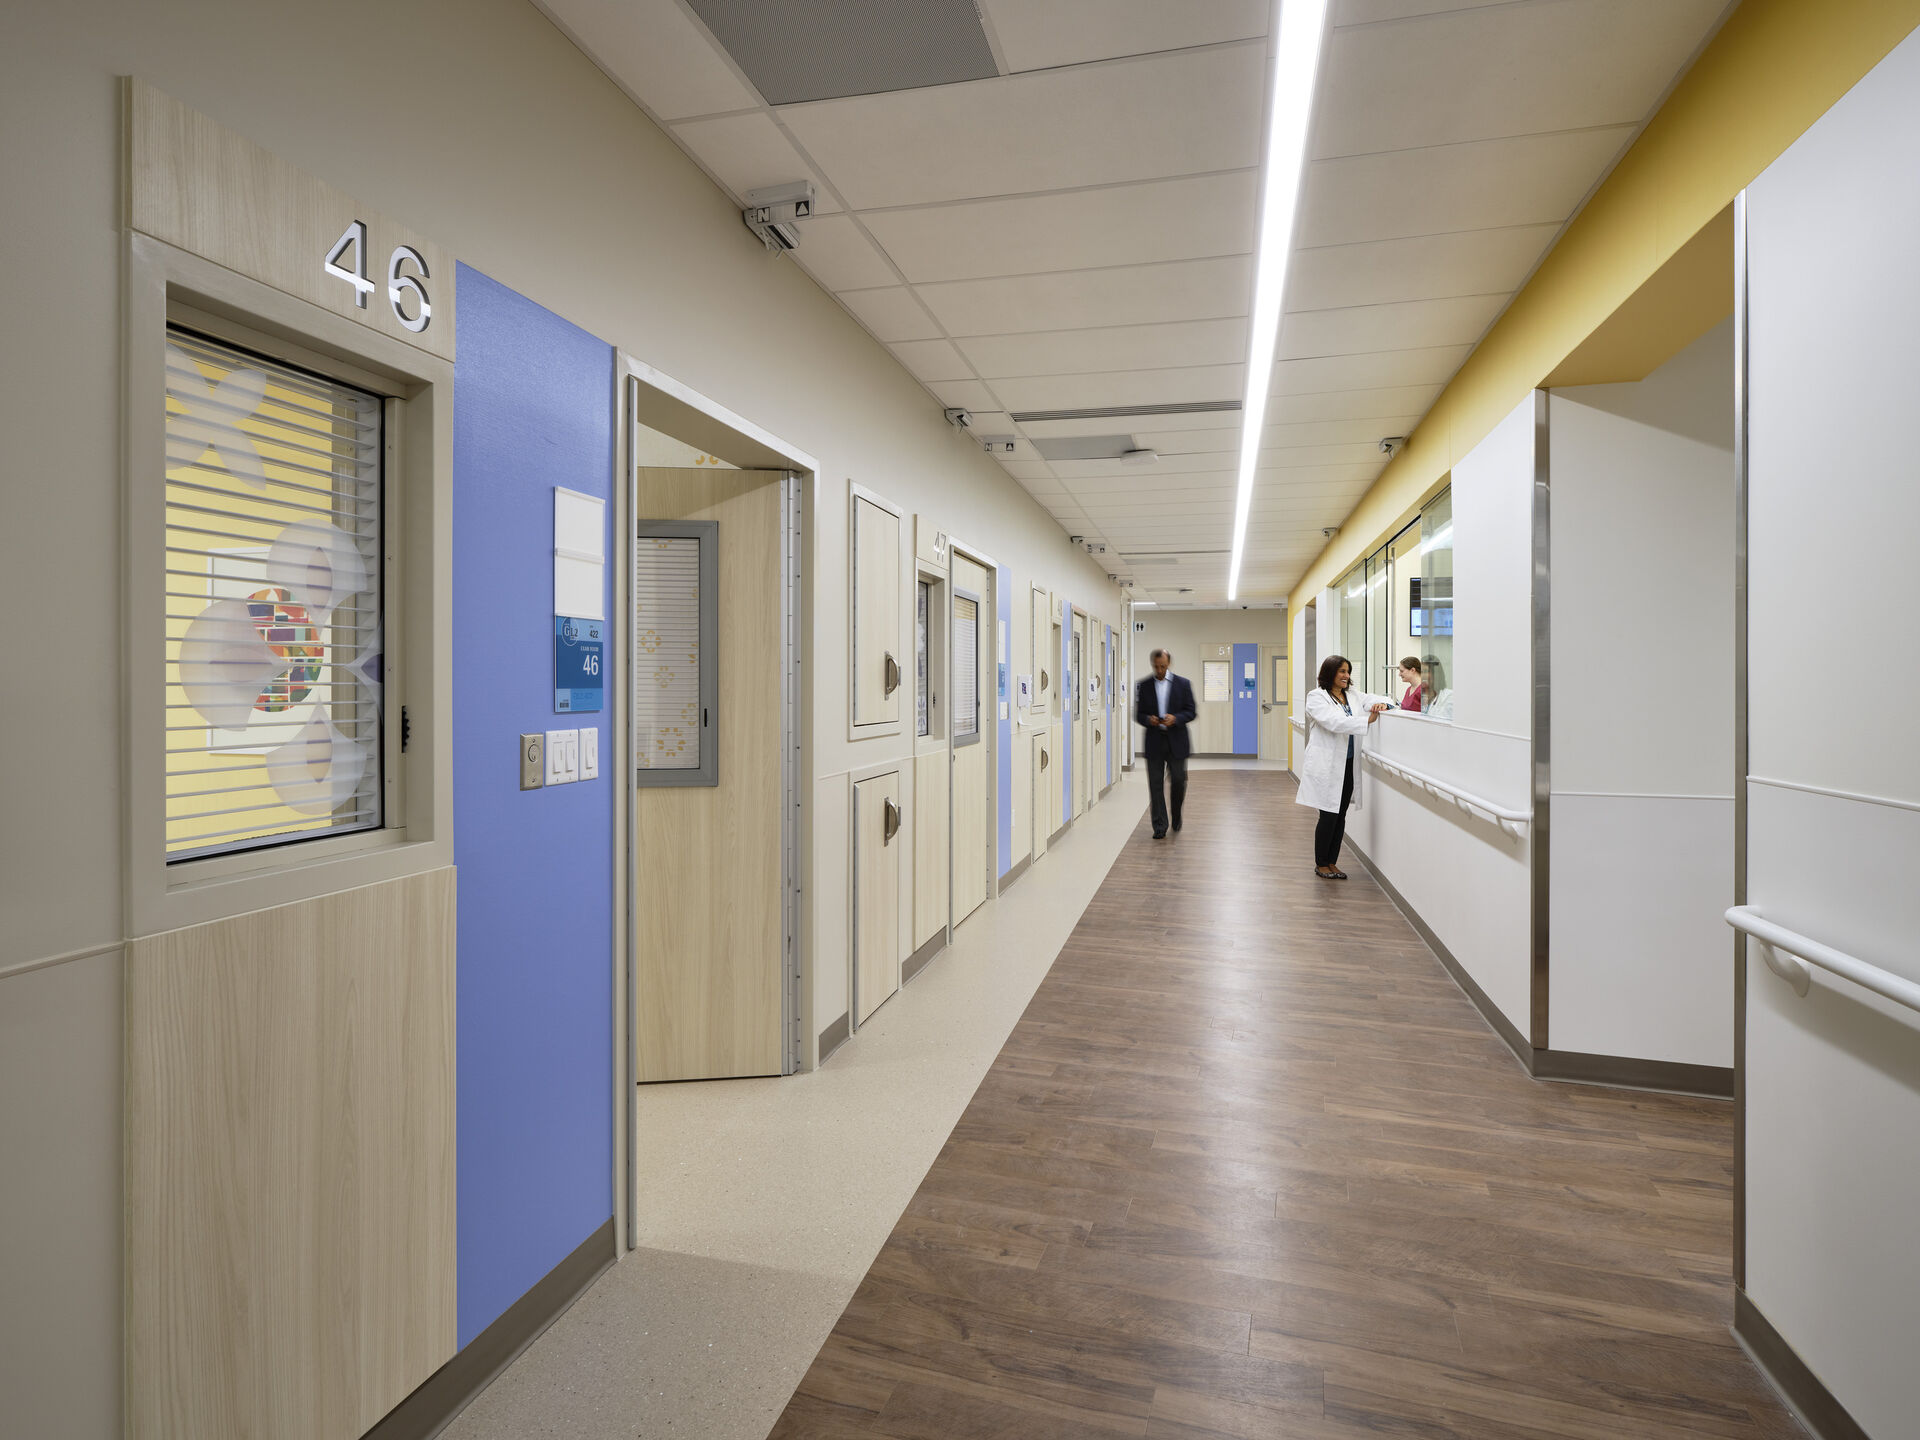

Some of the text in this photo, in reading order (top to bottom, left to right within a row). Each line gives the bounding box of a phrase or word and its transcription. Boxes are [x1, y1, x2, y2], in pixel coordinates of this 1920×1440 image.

[324, 219, 431, 333] 46
[934, 531, 946, 563] 47
[589, 630, 599, 639] 422
[1218, 646, 1231, 656] 51
[583, 654, 599, 676] 46
